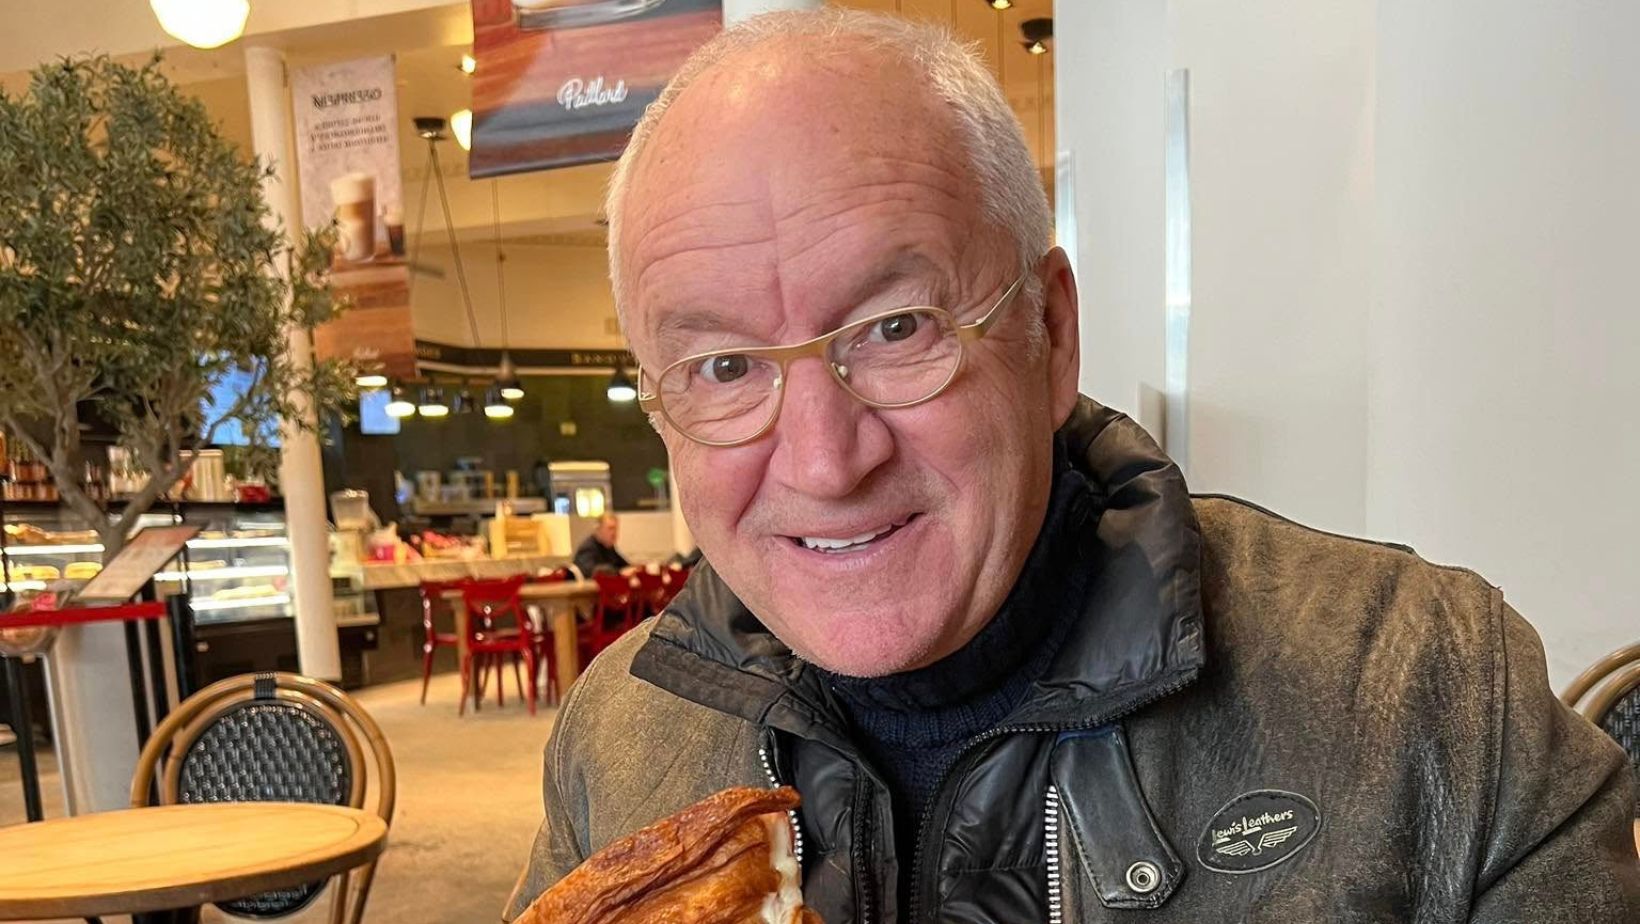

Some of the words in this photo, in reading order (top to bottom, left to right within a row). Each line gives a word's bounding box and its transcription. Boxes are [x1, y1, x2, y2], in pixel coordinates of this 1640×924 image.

[556, 76, 629, 110] Paillard
[1211, 821, 1242, 847] Lewis
[1242, 809, 1294, 836] Leathers
